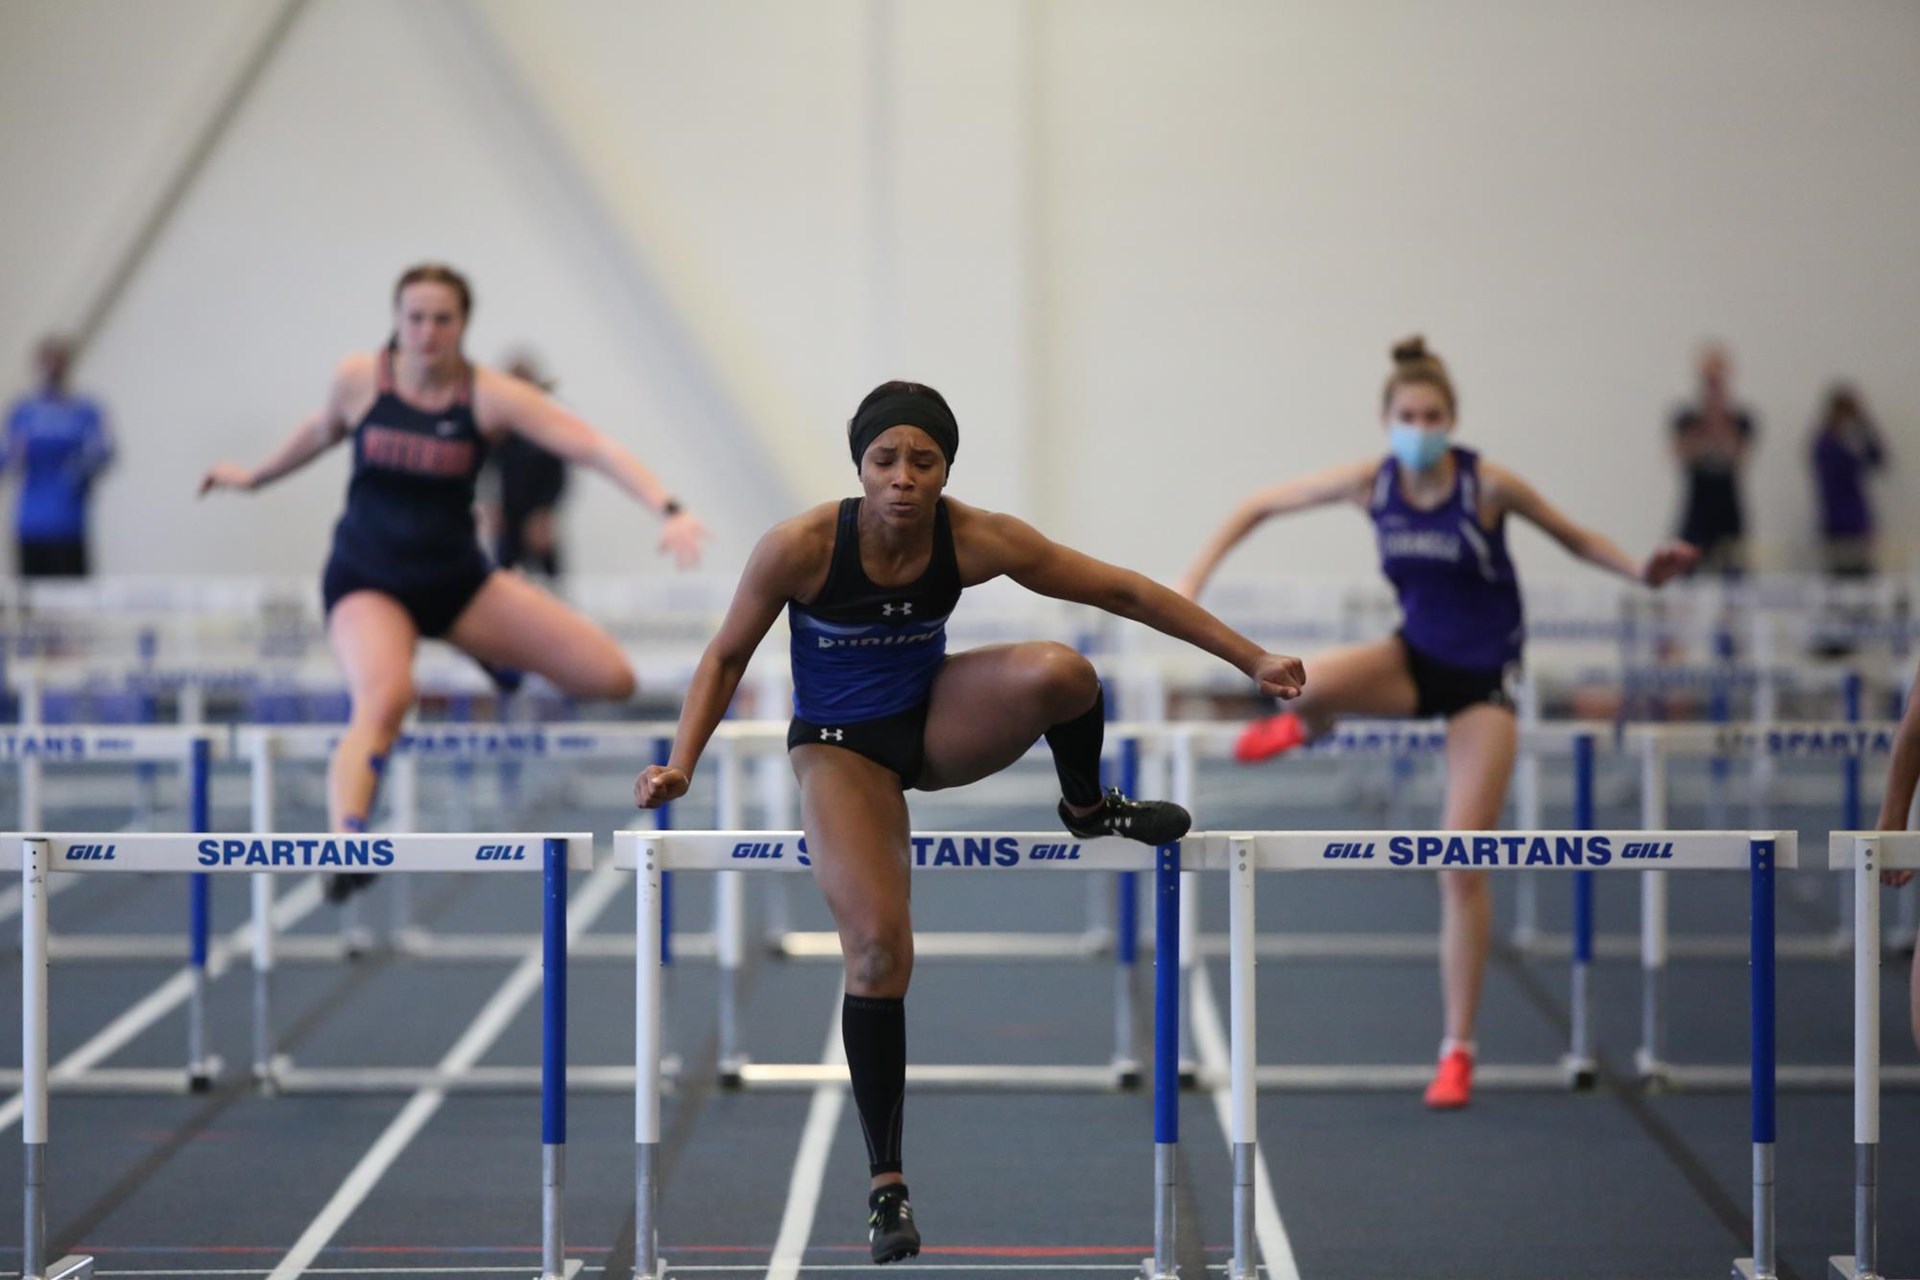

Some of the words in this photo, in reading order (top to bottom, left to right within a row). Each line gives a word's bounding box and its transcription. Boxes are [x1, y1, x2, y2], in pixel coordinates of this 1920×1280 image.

[0, 734, 86, 755] TANS
[1767, 732, 1893, 754] SPARTA
[66, 844, 116, 860] GILL
[197, 839, 395, 866] SPARTANS
[475, 844, 526, 860] GILL
[731, 843, 784, 859] GILL
[796, 837, 1019, 867] STANS
[1028, 844, 1081, 860] GILL
[1323, 842, 1375, 859] GILL
[1388, 836, 1612, 866] SPARTANS
[1621, 842, 1673, 859] GILL
